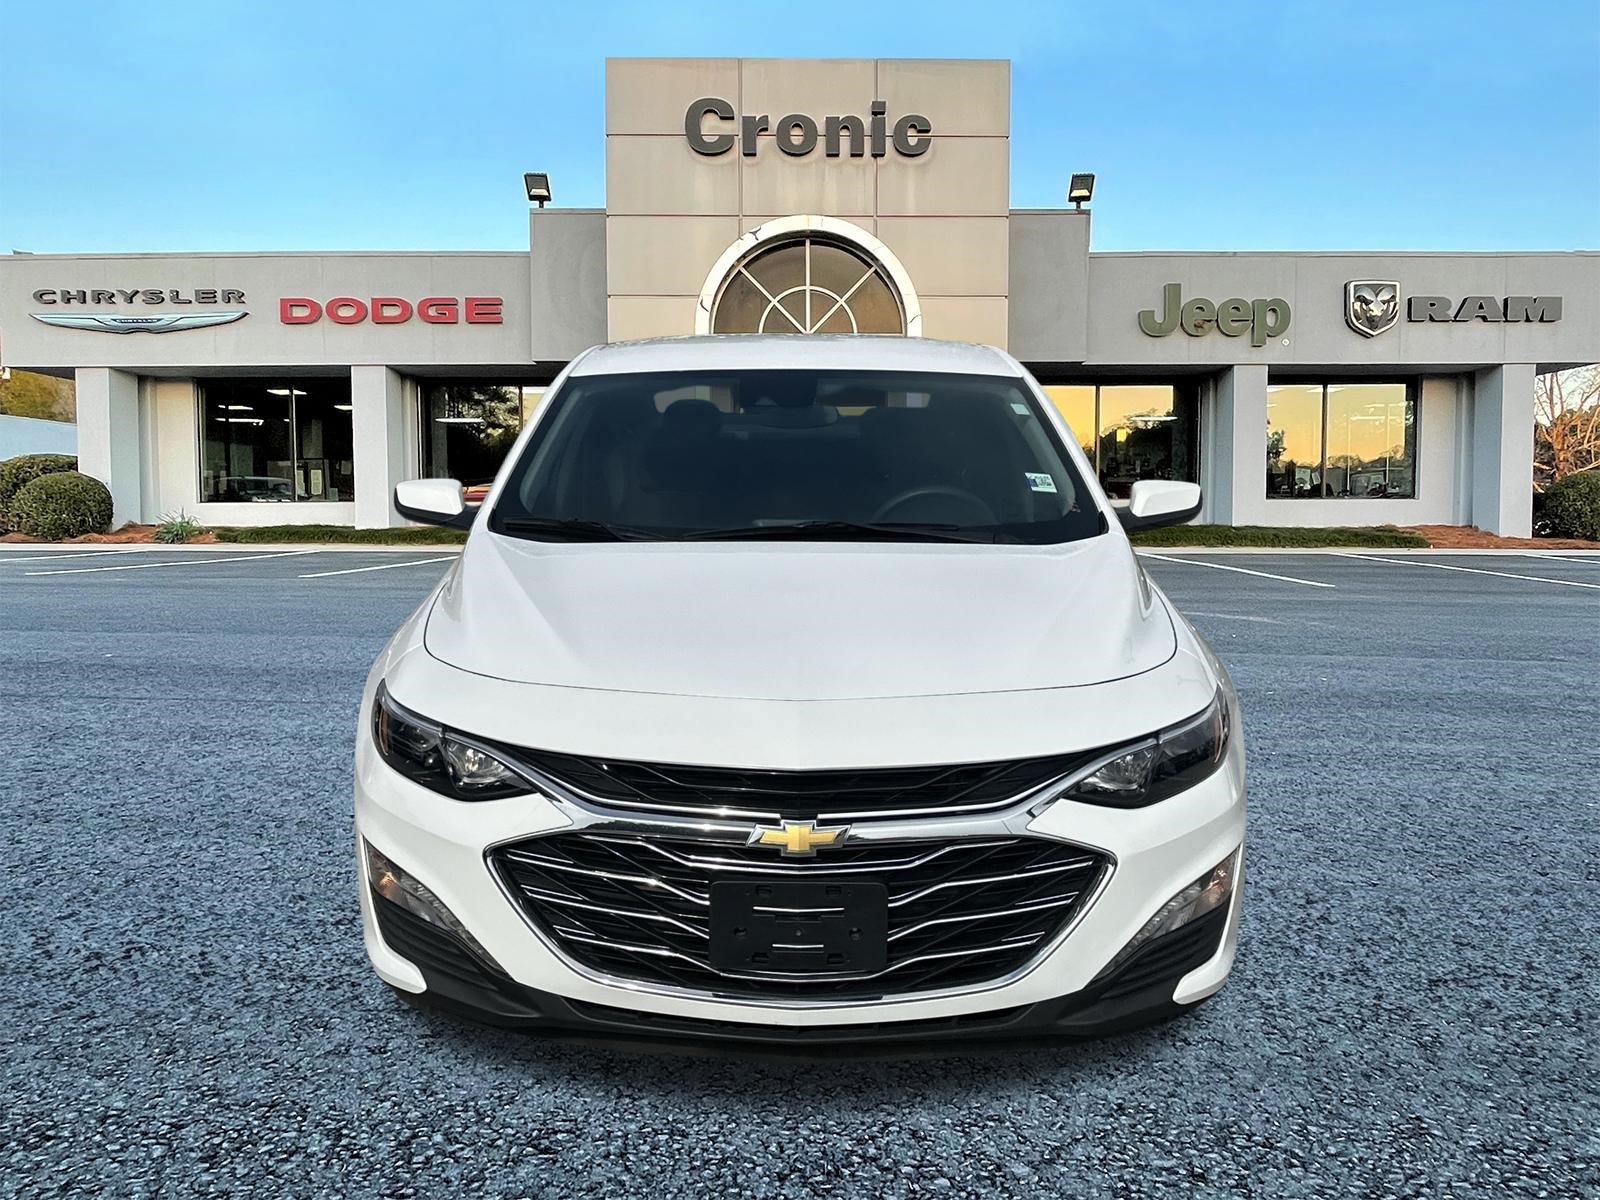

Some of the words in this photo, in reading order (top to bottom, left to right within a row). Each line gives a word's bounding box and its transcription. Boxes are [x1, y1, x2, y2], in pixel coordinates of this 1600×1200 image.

[685, 97, 932, 157] Cronic
[32, 289, 247, 305] CHRYSLER
[280, 297, 503, 324] DODGE
[1407, 296, 1563, 323] RAM
[1138, 283, 1291, 347] Jeep
